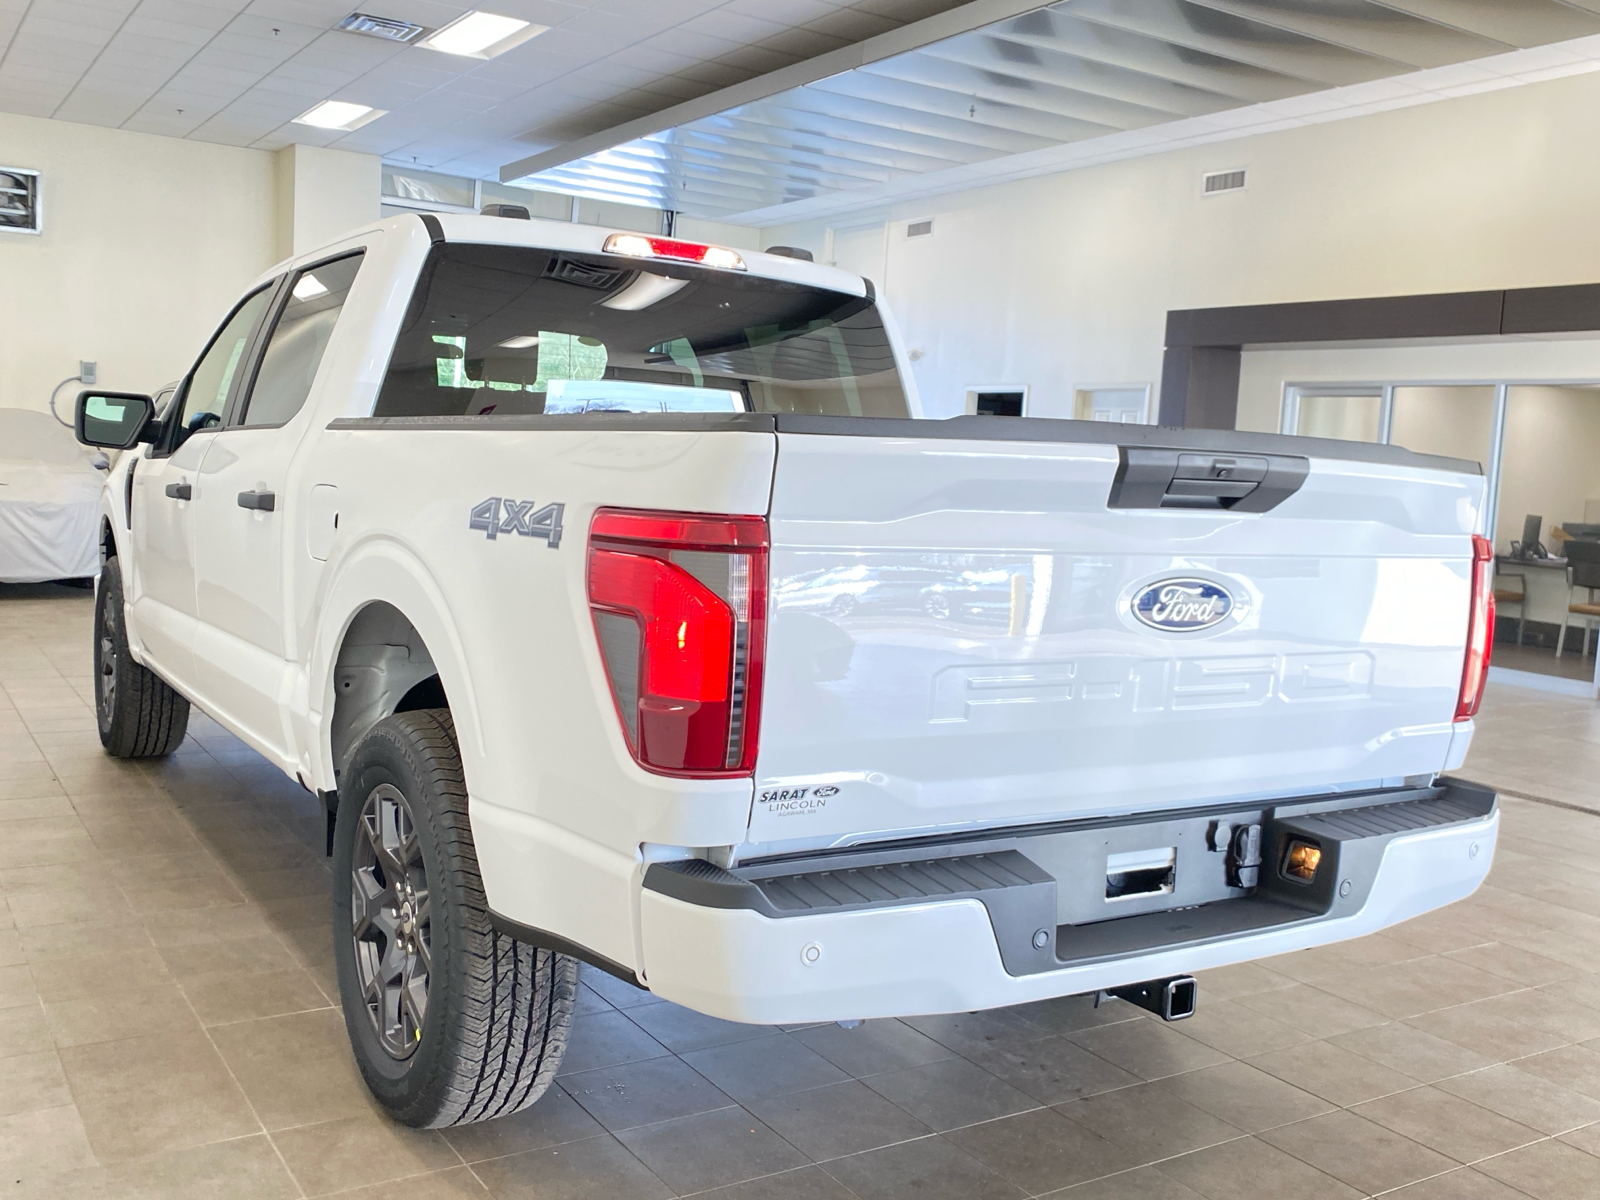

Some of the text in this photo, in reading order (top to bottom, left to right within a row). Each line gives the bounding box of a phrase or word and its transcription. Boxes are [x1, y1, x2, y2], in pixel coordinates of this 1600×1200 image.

[1152, 585, 1218, 622] Ford
[929, 650, 1376, 724] F-150
[759, 786, 837, 803] SARAT Ford
[768, 799, 826, 812] LINCOLN
[777, 810, 806, 818] AGAWAM,
